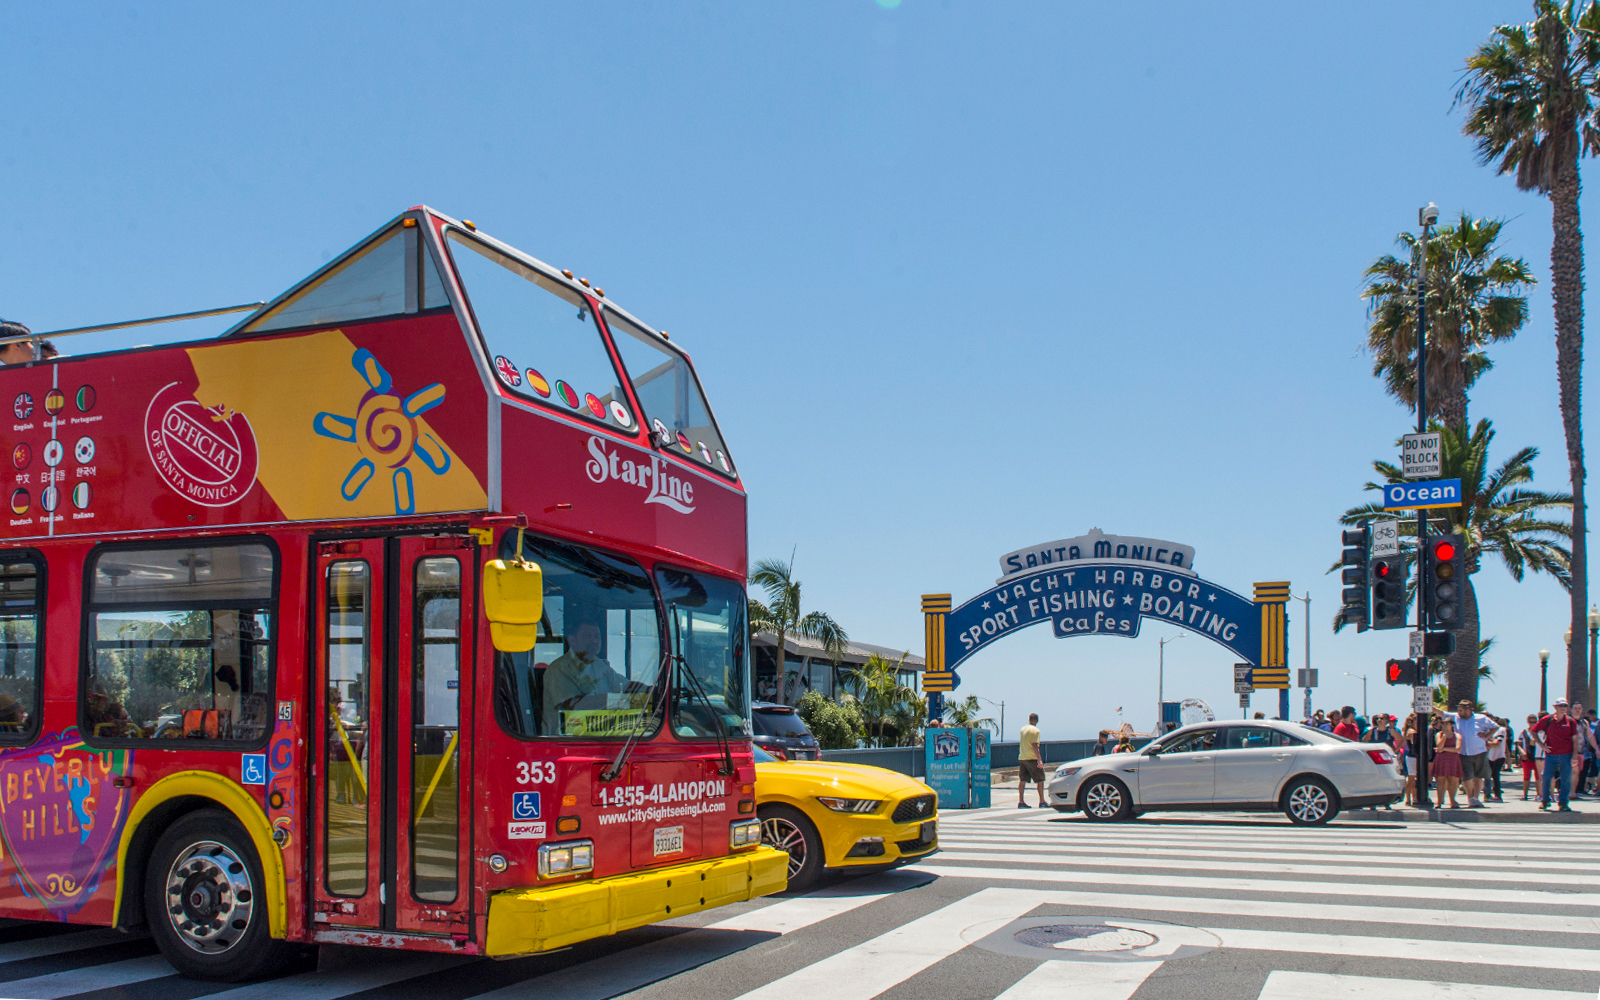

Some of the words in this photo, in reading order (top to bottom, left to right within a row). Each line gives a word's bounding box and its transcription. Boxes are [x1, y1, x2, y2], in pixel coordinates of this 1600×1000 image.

[13, 423, 34, 432] English
[71, 415, 103, 424] Portuguese
[151, 430, 162, 447] OF
[168, 414, 234, 473] OFFICIAL
[1405, 439, 1418, 450] DO
[1421, 438, 1438, 449] NOT
[1405, 452, 1439, 464] BLOCK
[76, 466, 96, 477] 한국어
[156, 450, 185, 489] SANTA
[1405, 465, 1439, 473] INTERSECTION
[16, 473, 30, 485] 中文
[187, 483, 238, 500] MONICA
[1390, 486, 1455, 502] Ocean
[10, 518, 33, 526] Deutsch
[1374, 543, 1396, 552] SIGNAL
[1006, 546, 1080, 574] SANTA
[1094, 540, 1184, 567] MONICA
[996, 572, 1076, 604] YACHT
[1095, 570, 1200, 599] HARBOR
[959, 605, 1018, 650] SPORT
[1028, 589, 1116, 618] FISHING
[1139, 592, 1239, 642] BOATING
[279, 705, 290, 719] 45
[585, 715, 617, 732] YELLOW
[7, 750, 114, 804] BEVERLY
[516, 761, 556, 784] 353
[599, 780, 725, 808] 1-855-4LAHOPON
[22, 796, 96, 841] HILLS
[598, 801, 726, 825] www.CitySightseeingLA.com
[656, 836, 682, 852] 93316E1
